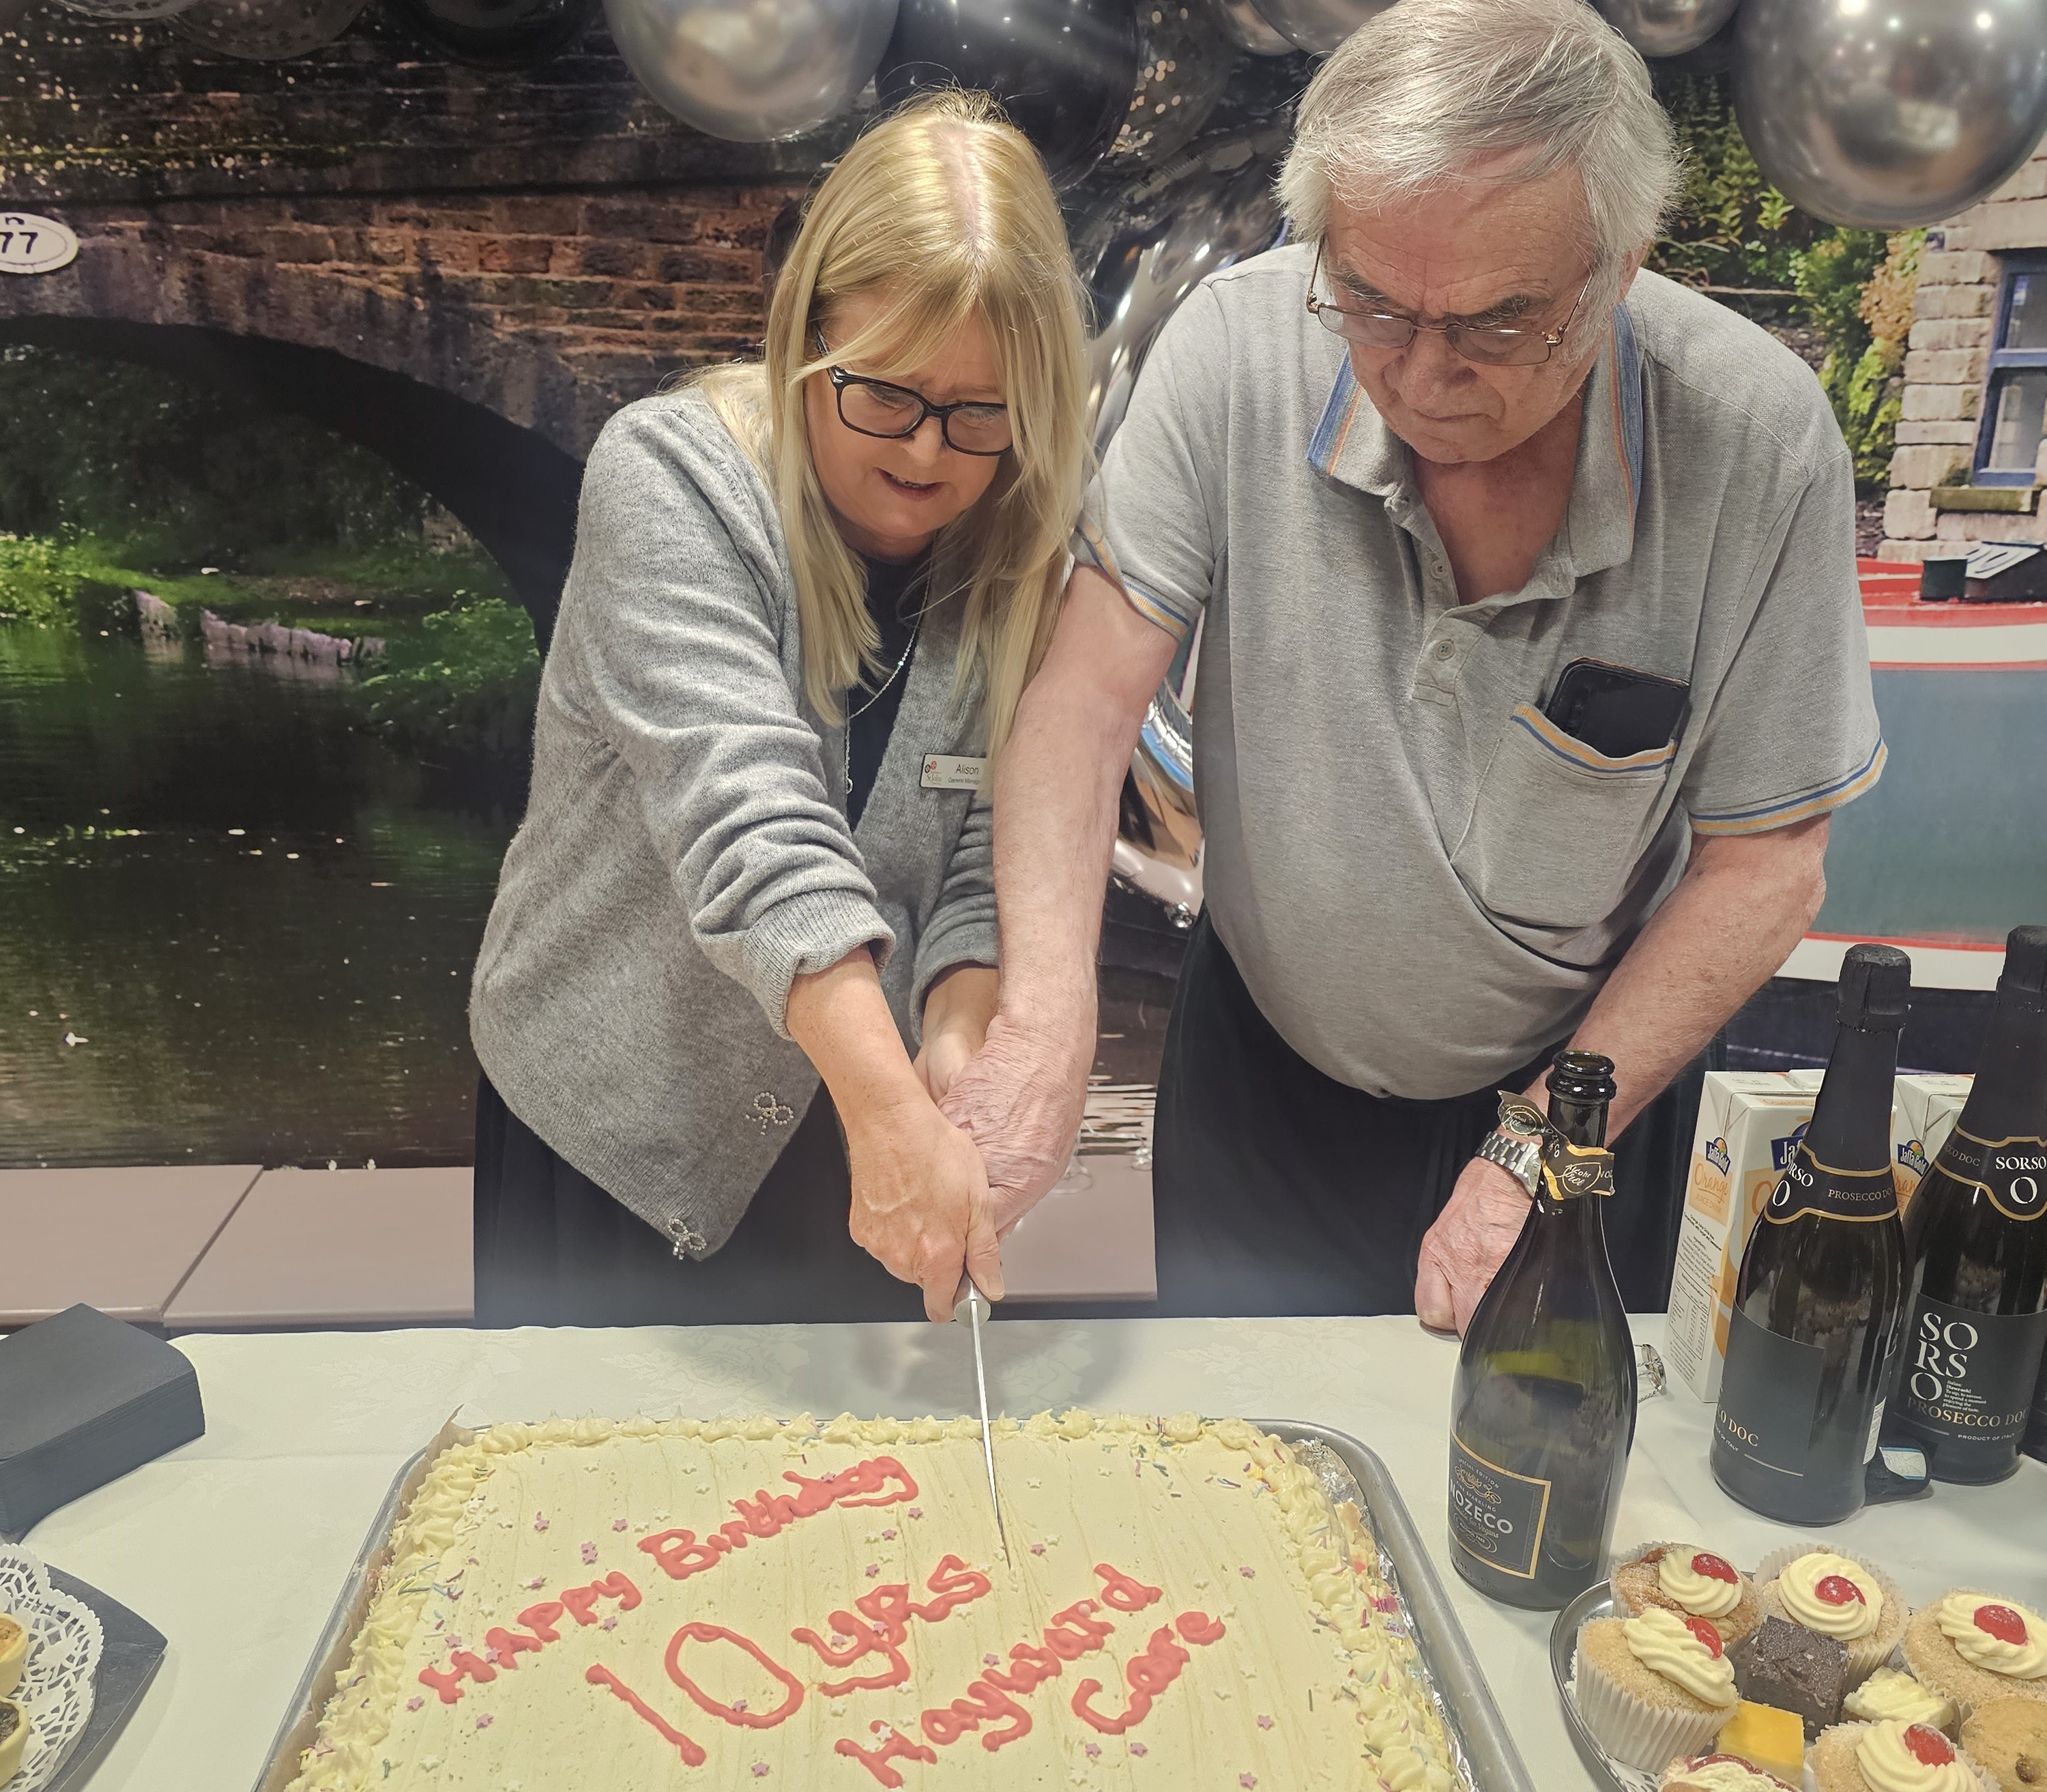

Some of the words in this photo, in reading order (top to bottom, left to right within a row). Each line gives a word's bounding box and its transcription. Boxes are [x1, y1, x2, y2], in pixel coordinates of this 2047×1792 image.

[955, 764, 979, 775] Alison
[1900, 1147, 1915, 1166] Jaffa
[1914, 1155, 1927, 1175] Gold
[1958, 1153, 1980, 1166] DOC
[1995, 1156, 2047, 1170] SORSO
[1694, 1163, 1728, 1204] Orange
[1828, 1189, 1881, 1201] PROSECCO
[1882, 1185, 1894, 1198] DO
[1920, 1312, 1978, 1350] SO
[1913, 1339, 1968, 1378] RS
[1908, 1397, 2001, 1428] PROSECCO
[1728, 1418, 1759, 1447] DOC
[1458, 1458, 1475, 1471] SPECIAL
[1476, 1469, 1500, 1489] EDITION
[1451, 1479, 1514, 1535] NOZECO
[1466, 1490, 1497, 1512] SPARKLING
[1477, 1522, 1500, 1540] Vegans
[834, 1563, 1163, 1789] Hayward
[1071, 1610, 1226, 1735] Care
[586, 1621, 804, 1767] 10
